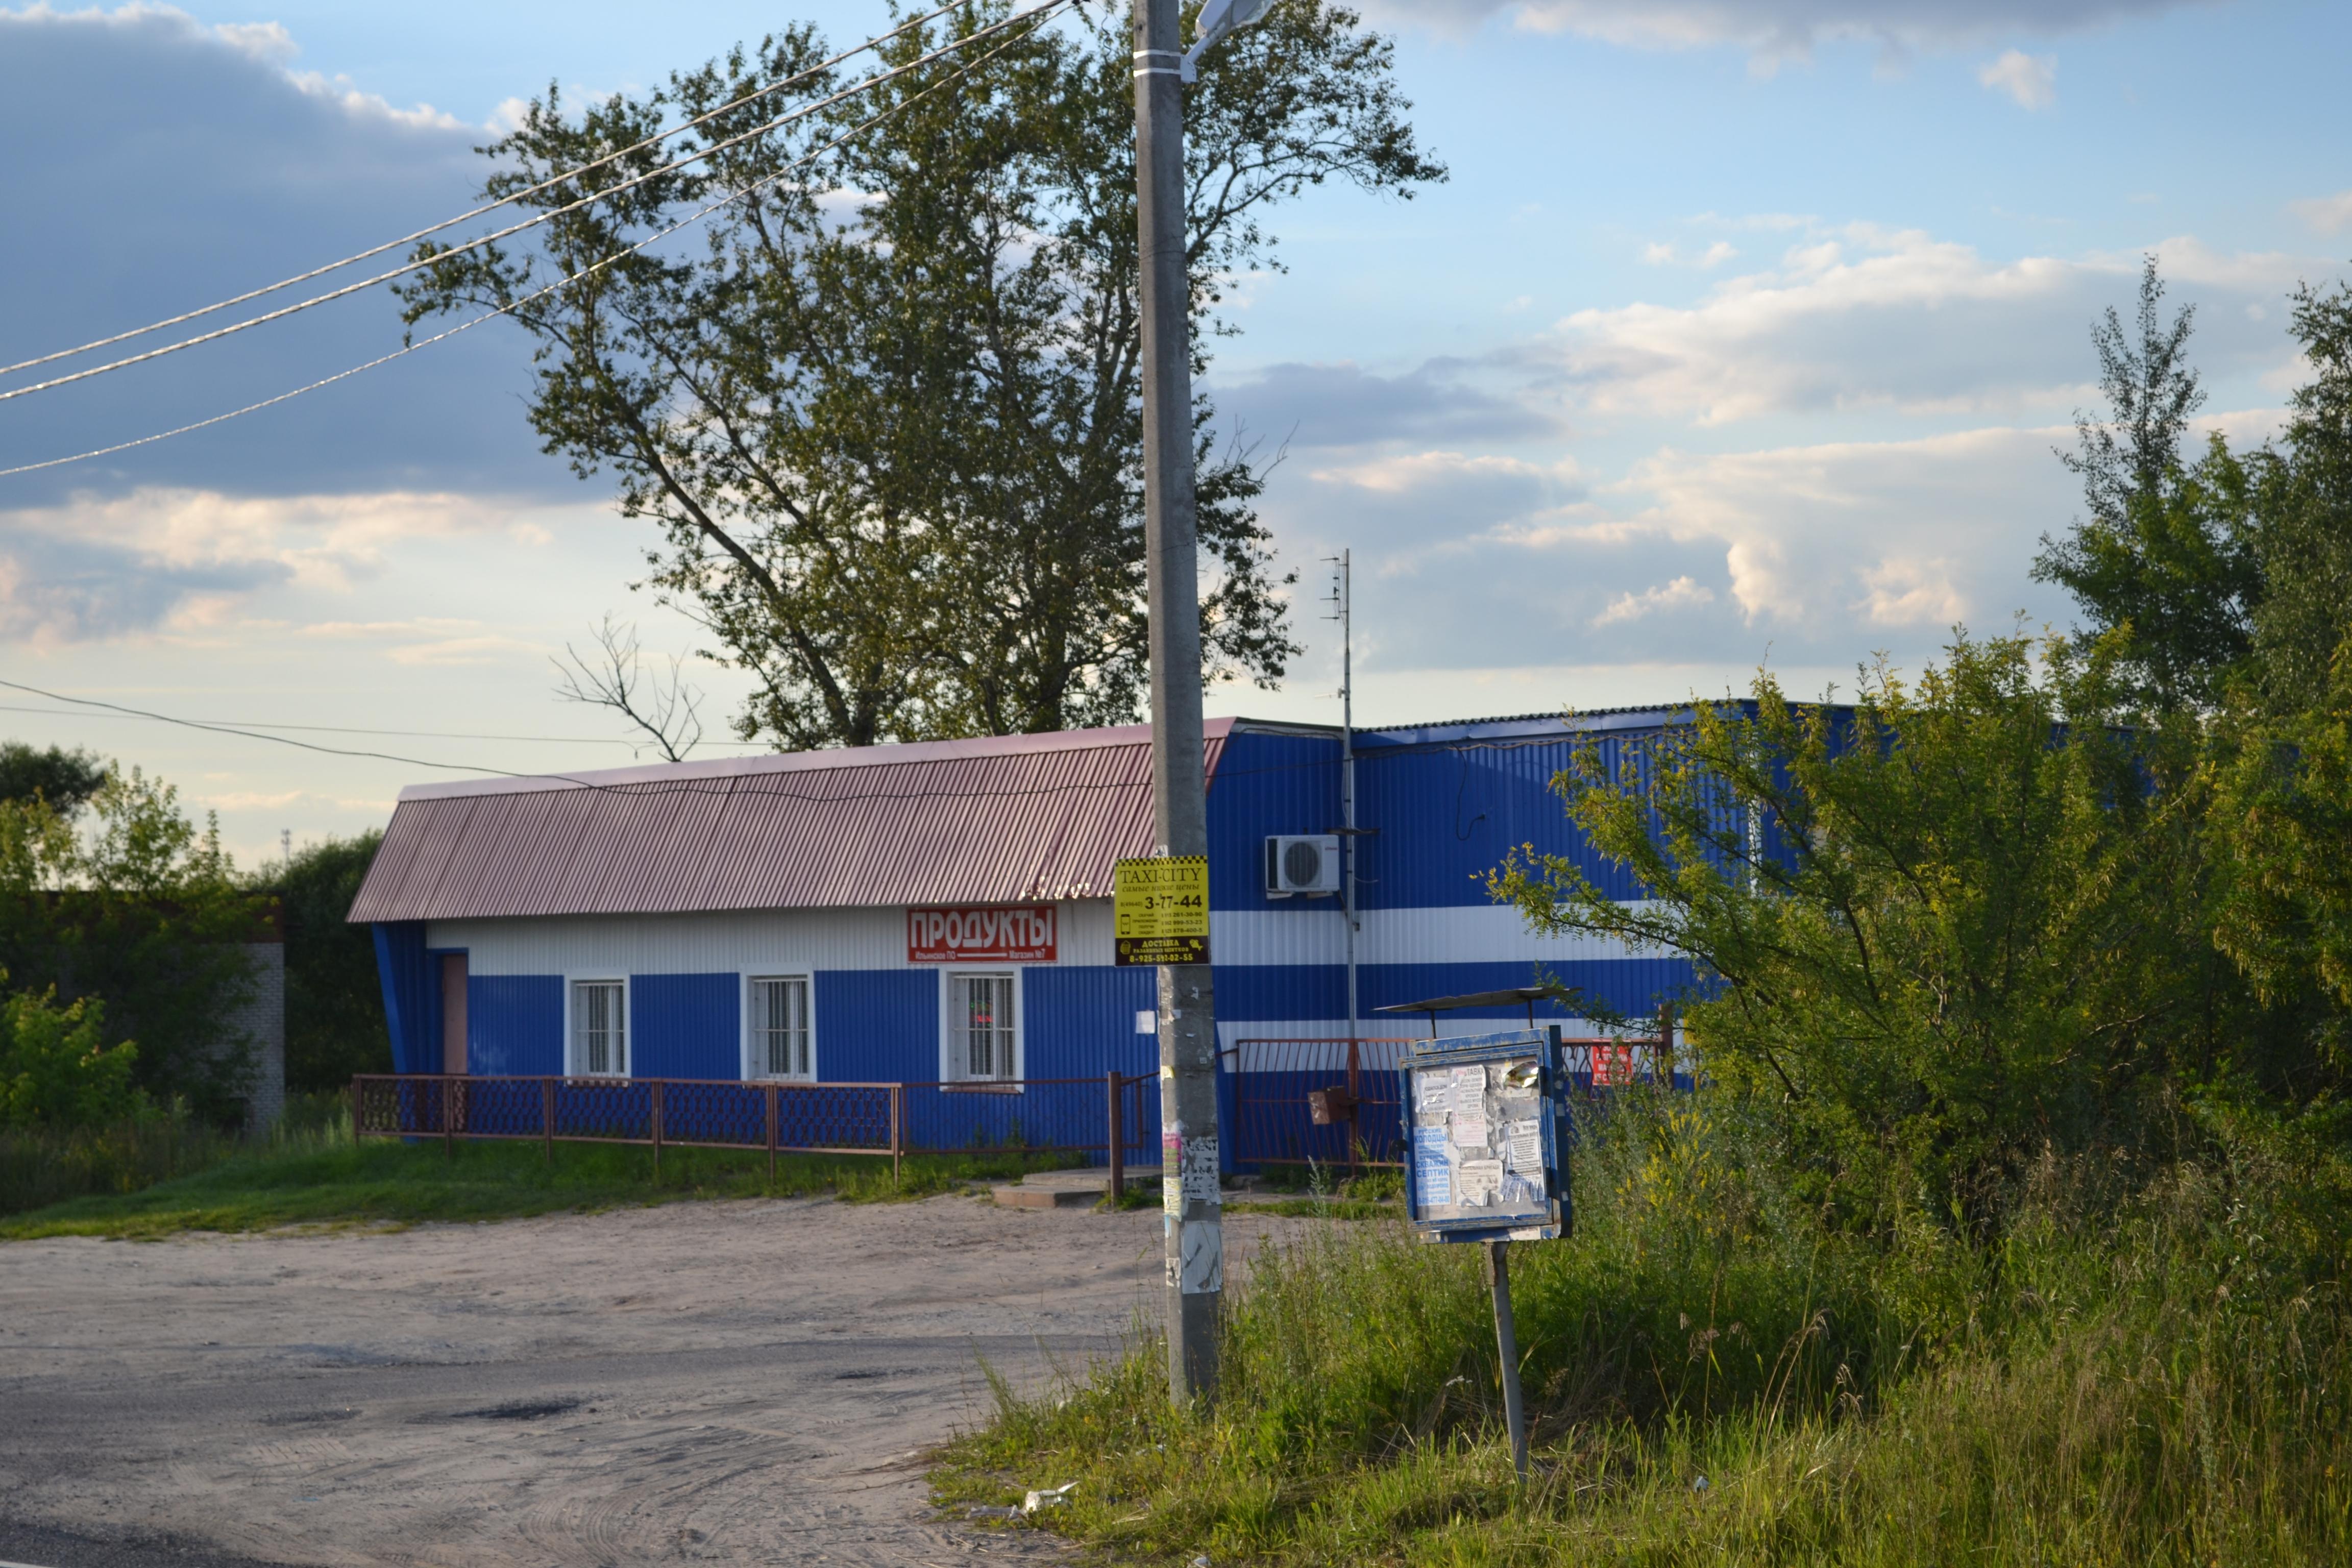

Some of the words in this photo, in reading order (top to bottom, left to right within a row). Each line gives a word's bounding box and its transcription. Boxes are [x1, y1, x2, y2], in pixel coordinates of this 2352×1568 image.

[1120, 868, 1202, 883] TAXI-CITY
[1145, 895, 1202, 909] 3-77-44
[911, 910, 1053, 948] ПРОДУКТЫ
[1142, 940, 1179, 948] ДОСТАВКА
[947, 950, 956, 960] ПО
[1414, 1134, 1447, 1144] КОЛОДЦЫ
[1416, 1160, 1449, 1168] СКВАЖИН
[1417, 1168, 1449, 1178] СЕПТИК
